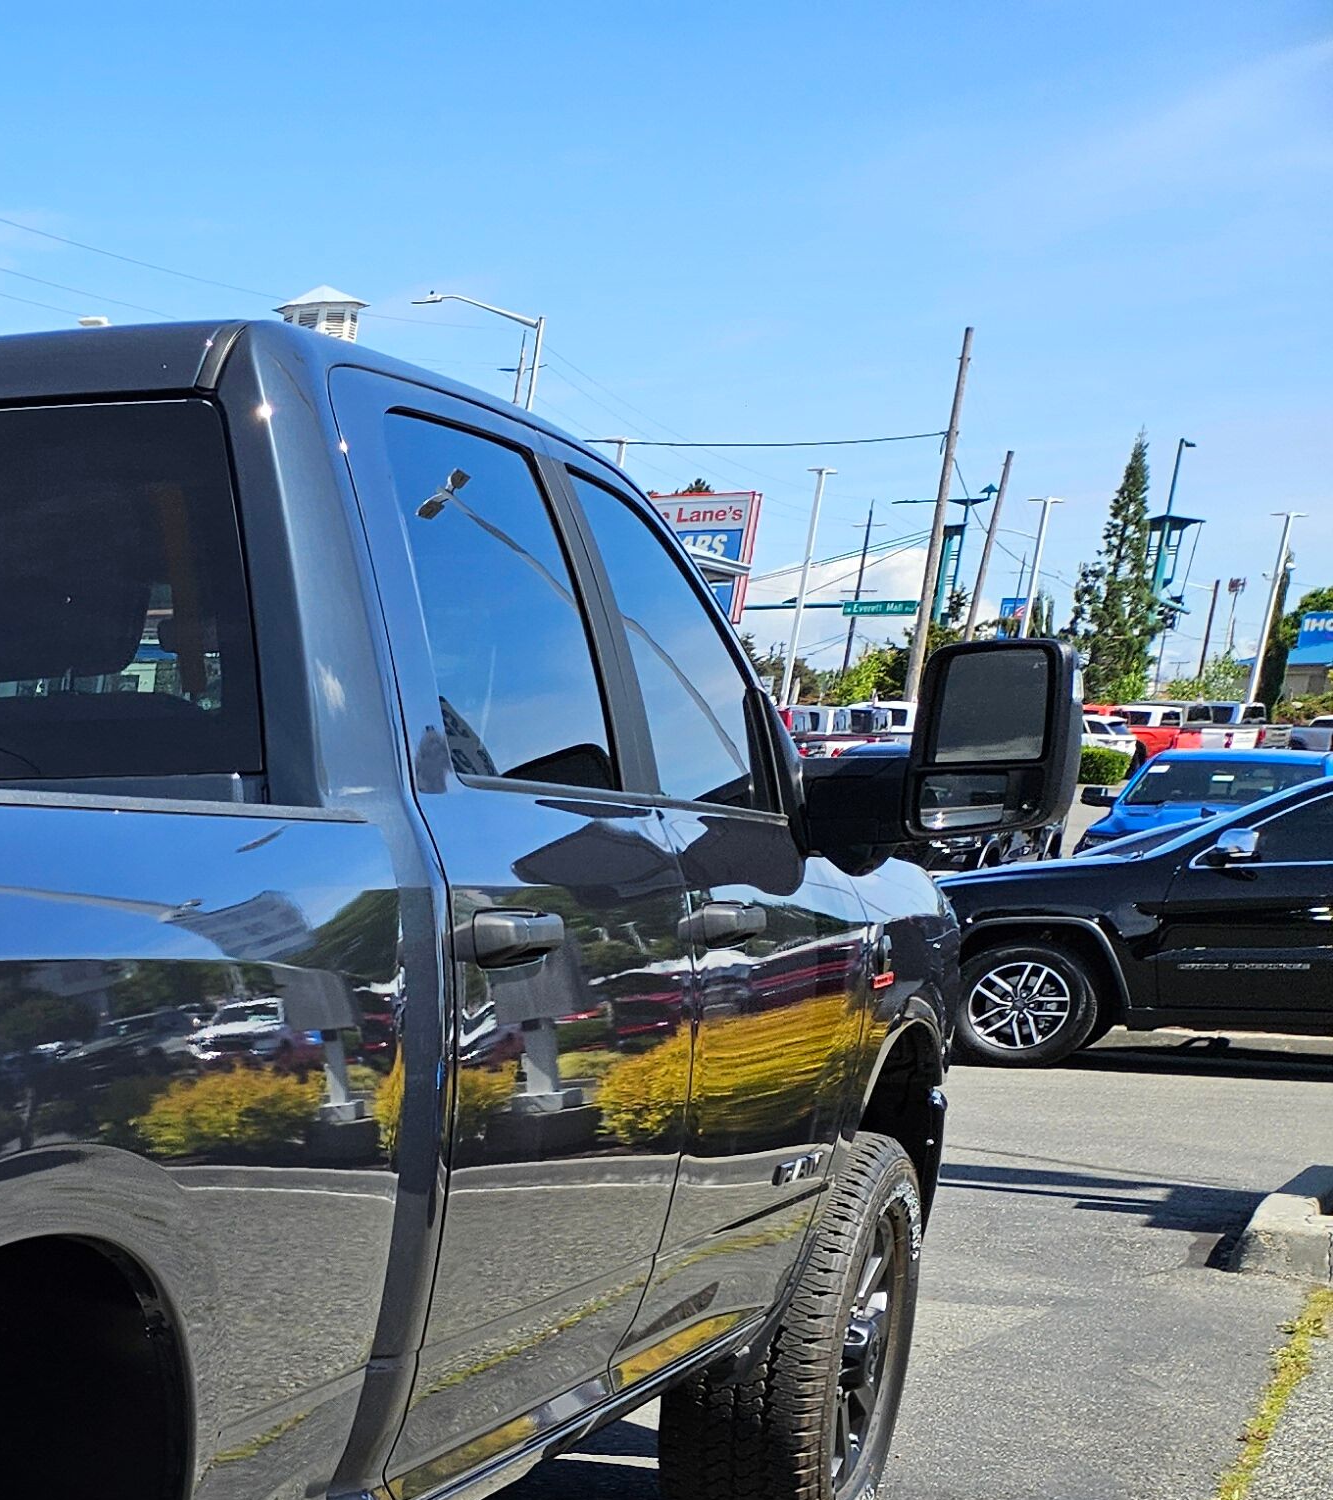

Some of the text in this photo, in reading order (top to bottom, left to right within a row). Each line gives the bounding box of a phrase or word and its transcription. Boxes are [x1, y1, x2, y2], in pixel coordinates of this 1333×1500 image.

[677, 506, 743, 523] Lane's
[683, 534, 728, 557] ARS
[1303, 617, 1333, 632] IHO
